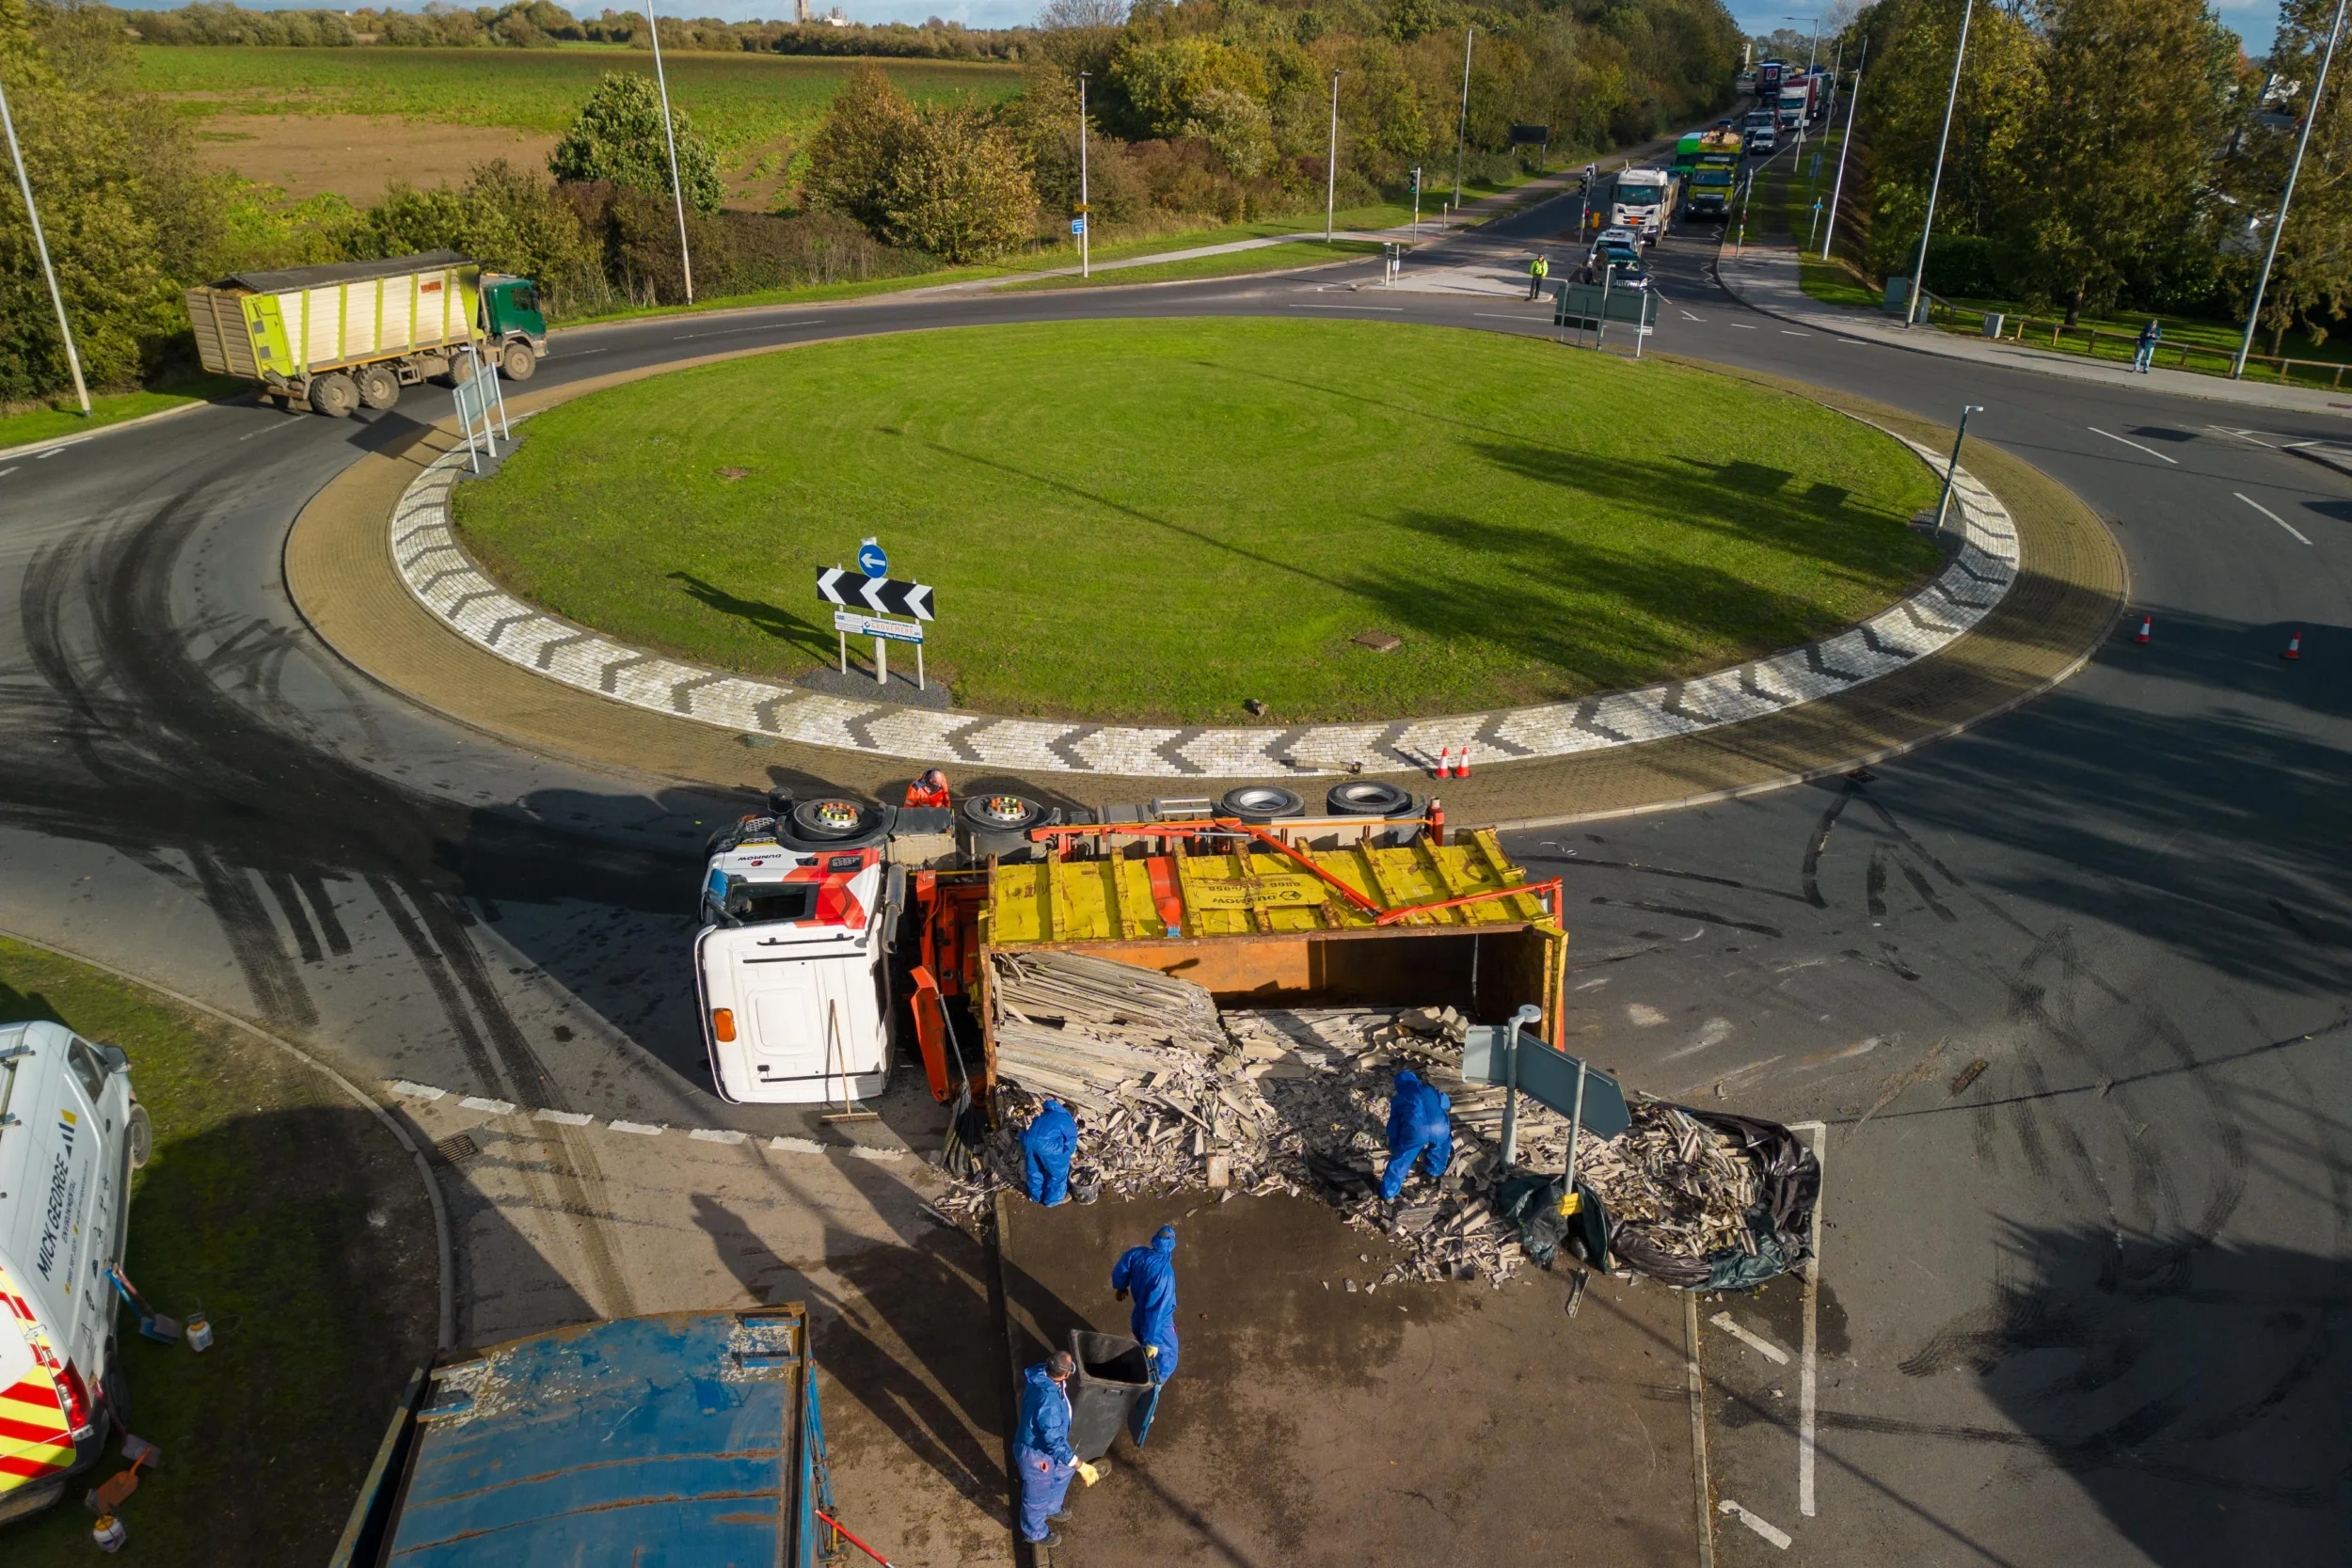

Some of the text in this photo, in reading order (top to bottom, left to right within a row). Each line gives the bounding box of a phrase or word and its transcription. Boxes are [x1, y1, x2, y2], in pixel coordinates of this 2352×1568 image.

[871, 623, 914, 635] GROVEMERE
[37, 1151, 70, 1281] MICK GEORGE
[61, 1180, 76, 1243] ENVIRONMENTAL
